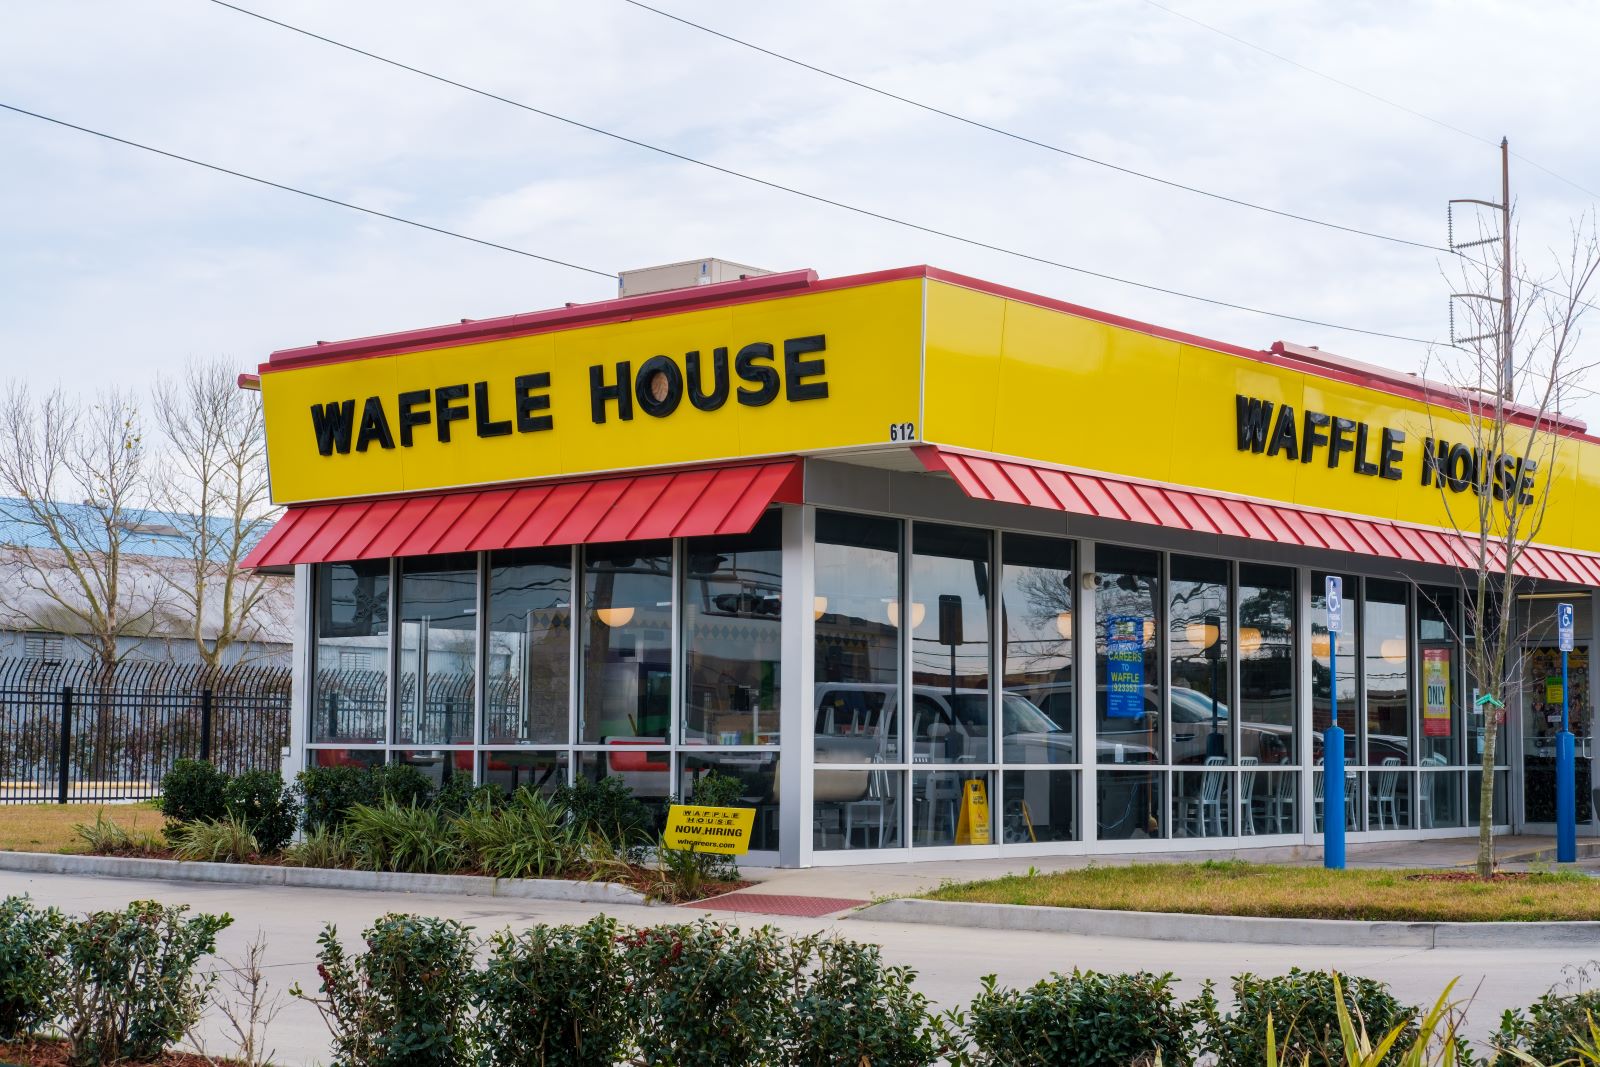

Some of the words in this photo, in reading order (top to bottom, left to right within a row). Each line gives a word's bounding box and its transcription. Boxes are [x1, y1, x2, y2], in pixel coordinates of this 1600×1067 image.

[310, 371, 554, 457] WAFFLE
[589, 334, 829, 425] HOUSE
[890, 422, 914, 441] 612
[1236, 394, 1406, 481] WAFFLE
[1421, 436, 1537, 506] HOUSE
[1108, 651, 1142, 662] CAREERS
[1121, 663, 1129, 671] TO
[1110, 672, 1139, 683] WAFFLE
[1427, 685, 1446, 705] ONLY
[684, 810, 740, 819] WAFFLE
[688, 817, 733, 825] HOUSE
[675, 825, 702, 834] NOW
[704, 827, 743, 837] HIRING
[678, 839, 735, 848] whcareers.com
